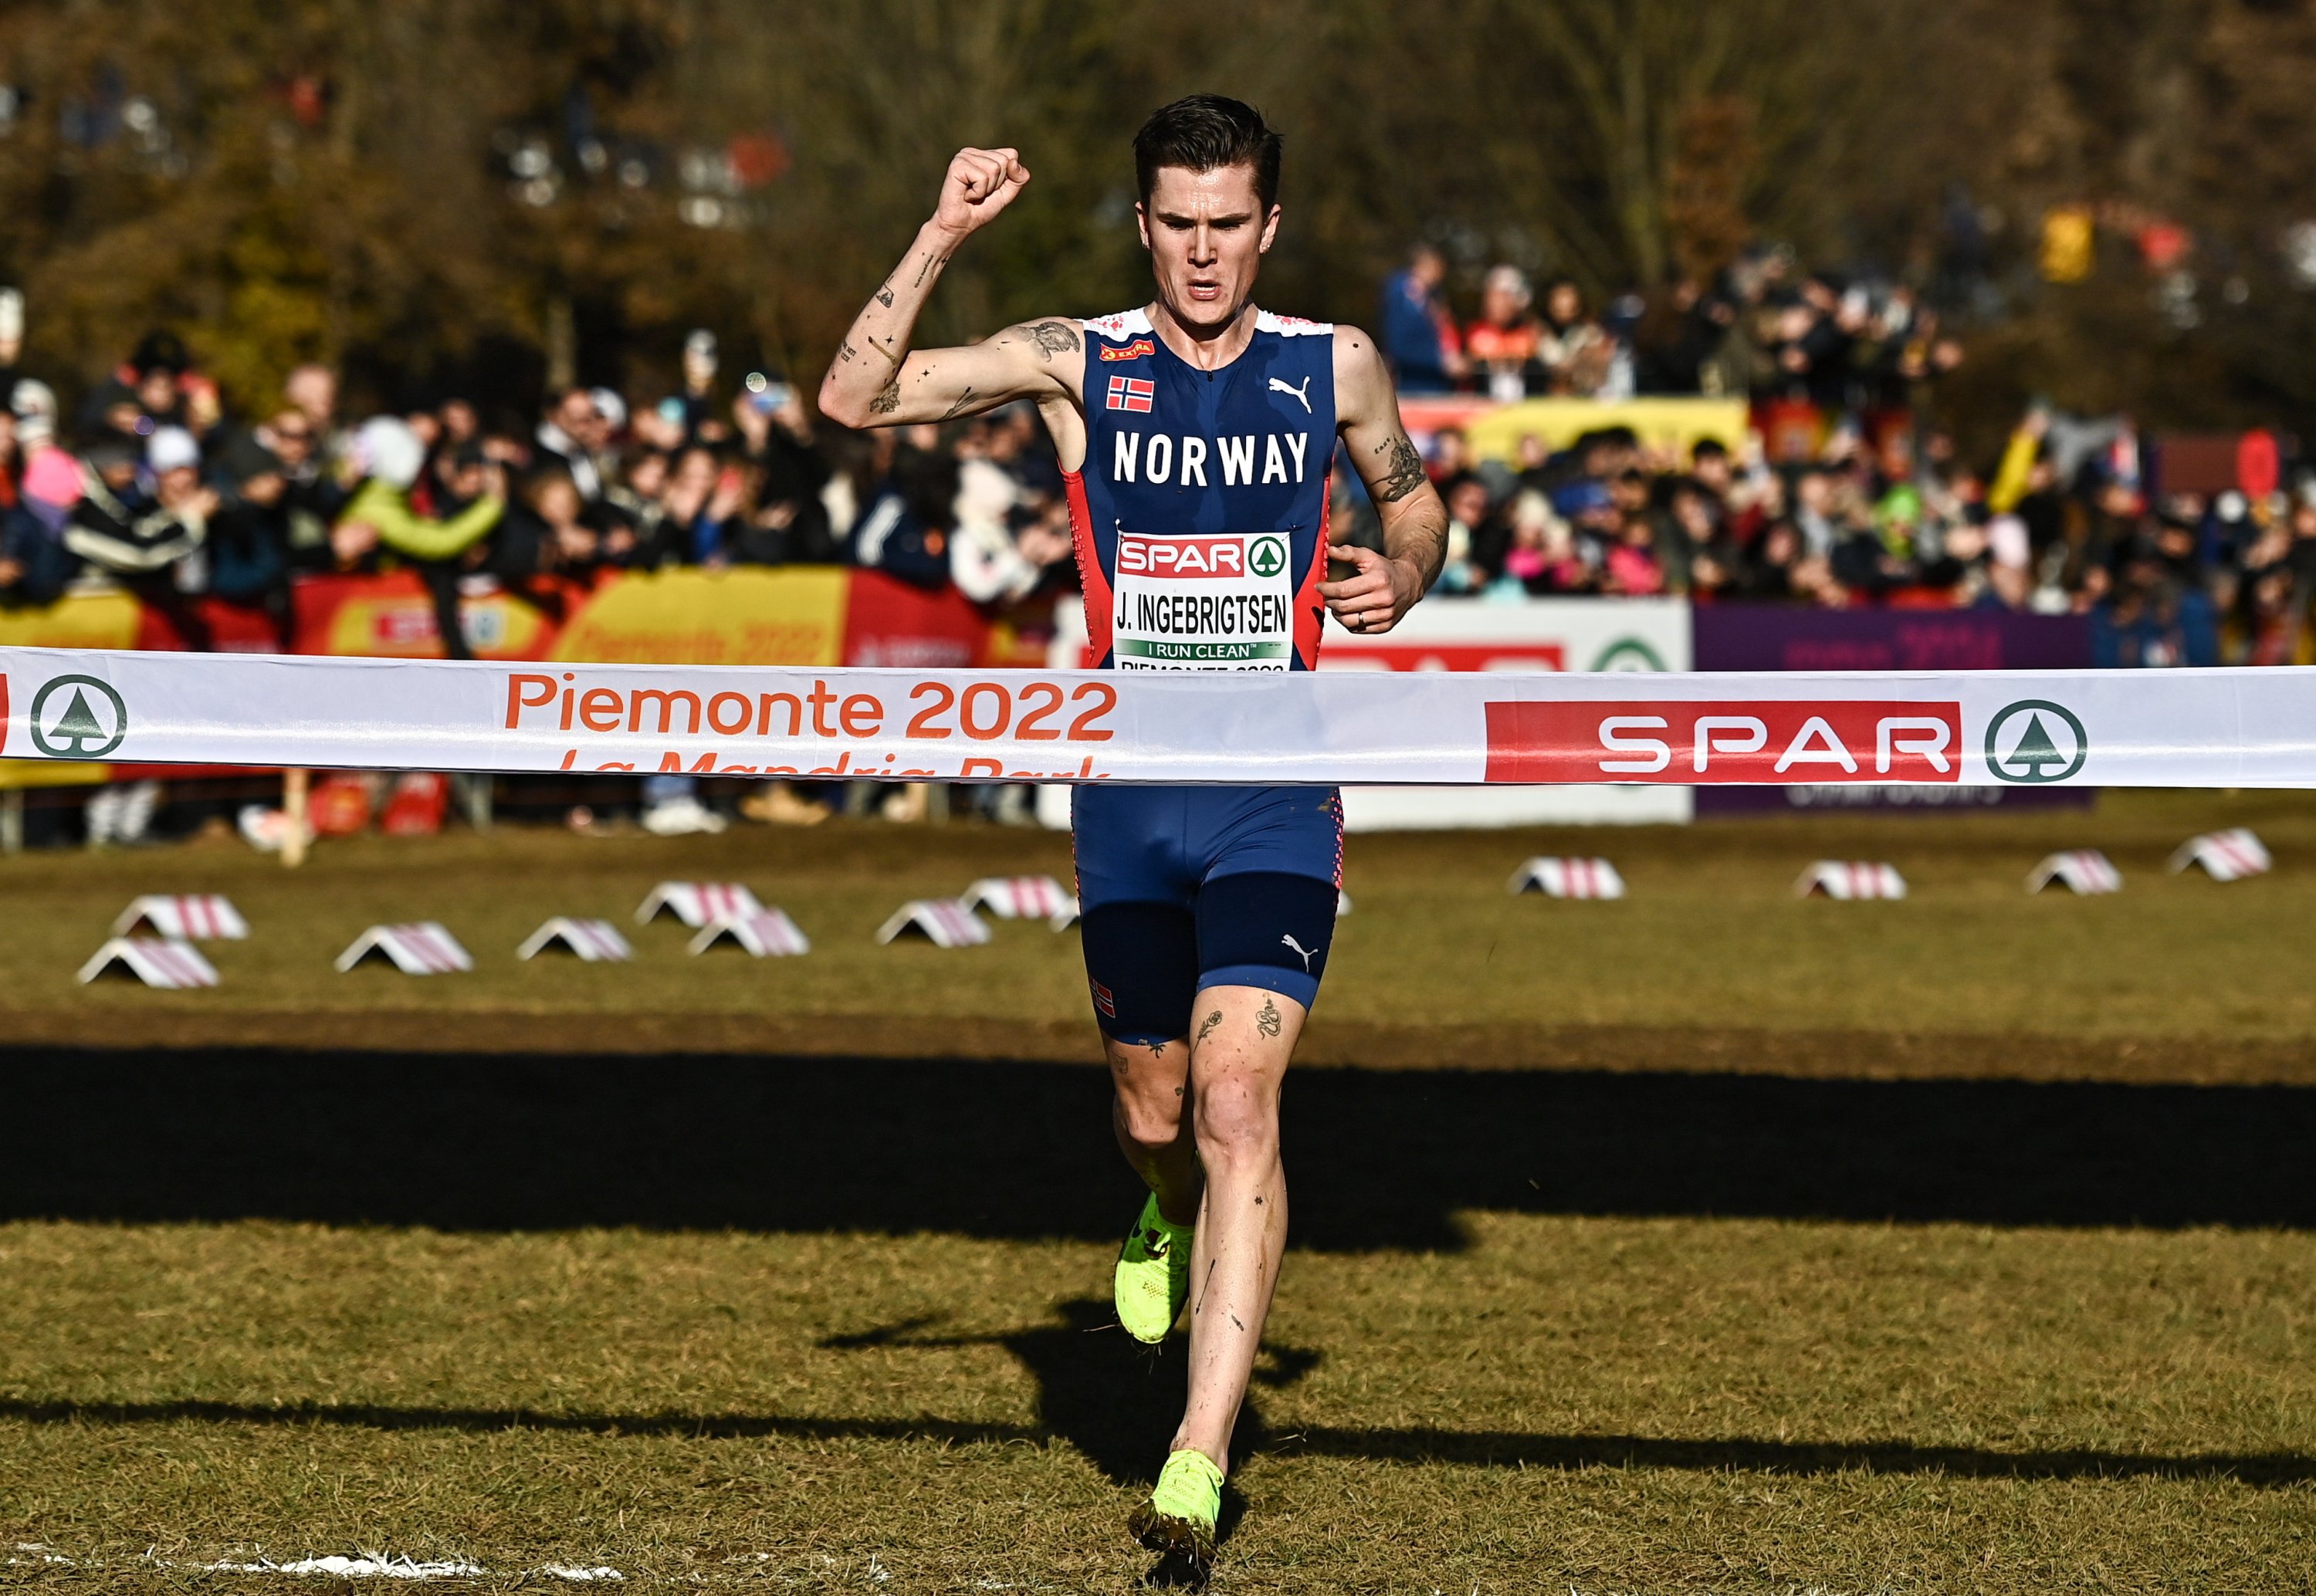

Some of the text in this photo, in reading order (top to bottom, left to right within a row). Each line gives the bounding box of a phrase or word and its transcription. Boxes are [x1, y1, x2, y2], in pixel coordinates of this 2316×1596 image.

[1117, 343, 1151, 358] EXTRA
[1113, 431, 1308, 487] NORWAY
[1120, 541, 1241, 573] SPAR
[1117, 591, 1286, 634] J. INGEBRIGTSEN
[1148, 642, 1153, 655] I
[1156, 644, 1191, 658] RUN
[504, 672, 1117, 742] Piemonte 2022
[1598, 715, 1951, 774] SPAR
